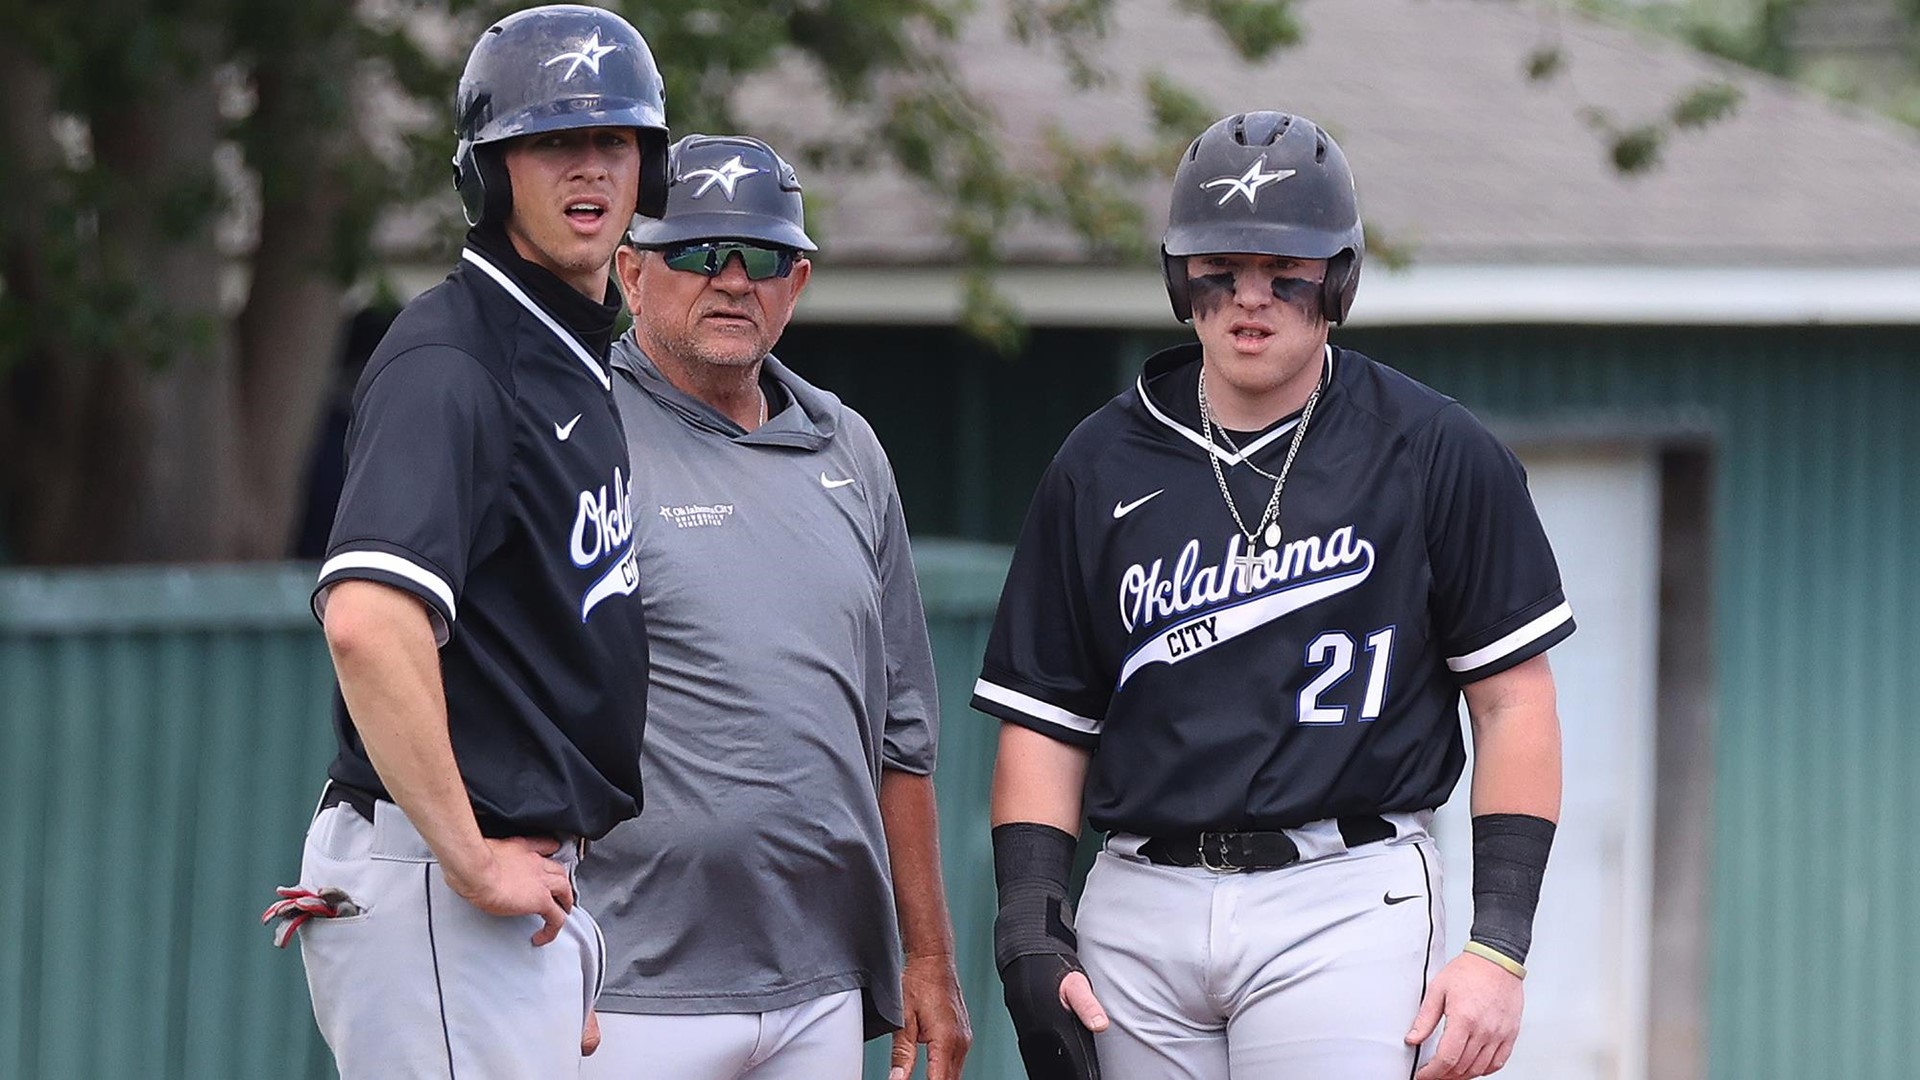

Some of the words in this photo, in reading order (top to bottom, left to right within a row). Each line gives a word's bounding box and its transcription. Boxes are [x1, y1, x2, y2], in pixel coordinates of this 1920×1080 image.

[1119, 524, 1360, 634] Oklahoma
[1166, 616, 1218, 658] CITY
[1296, 625, 1397, 725] 21
